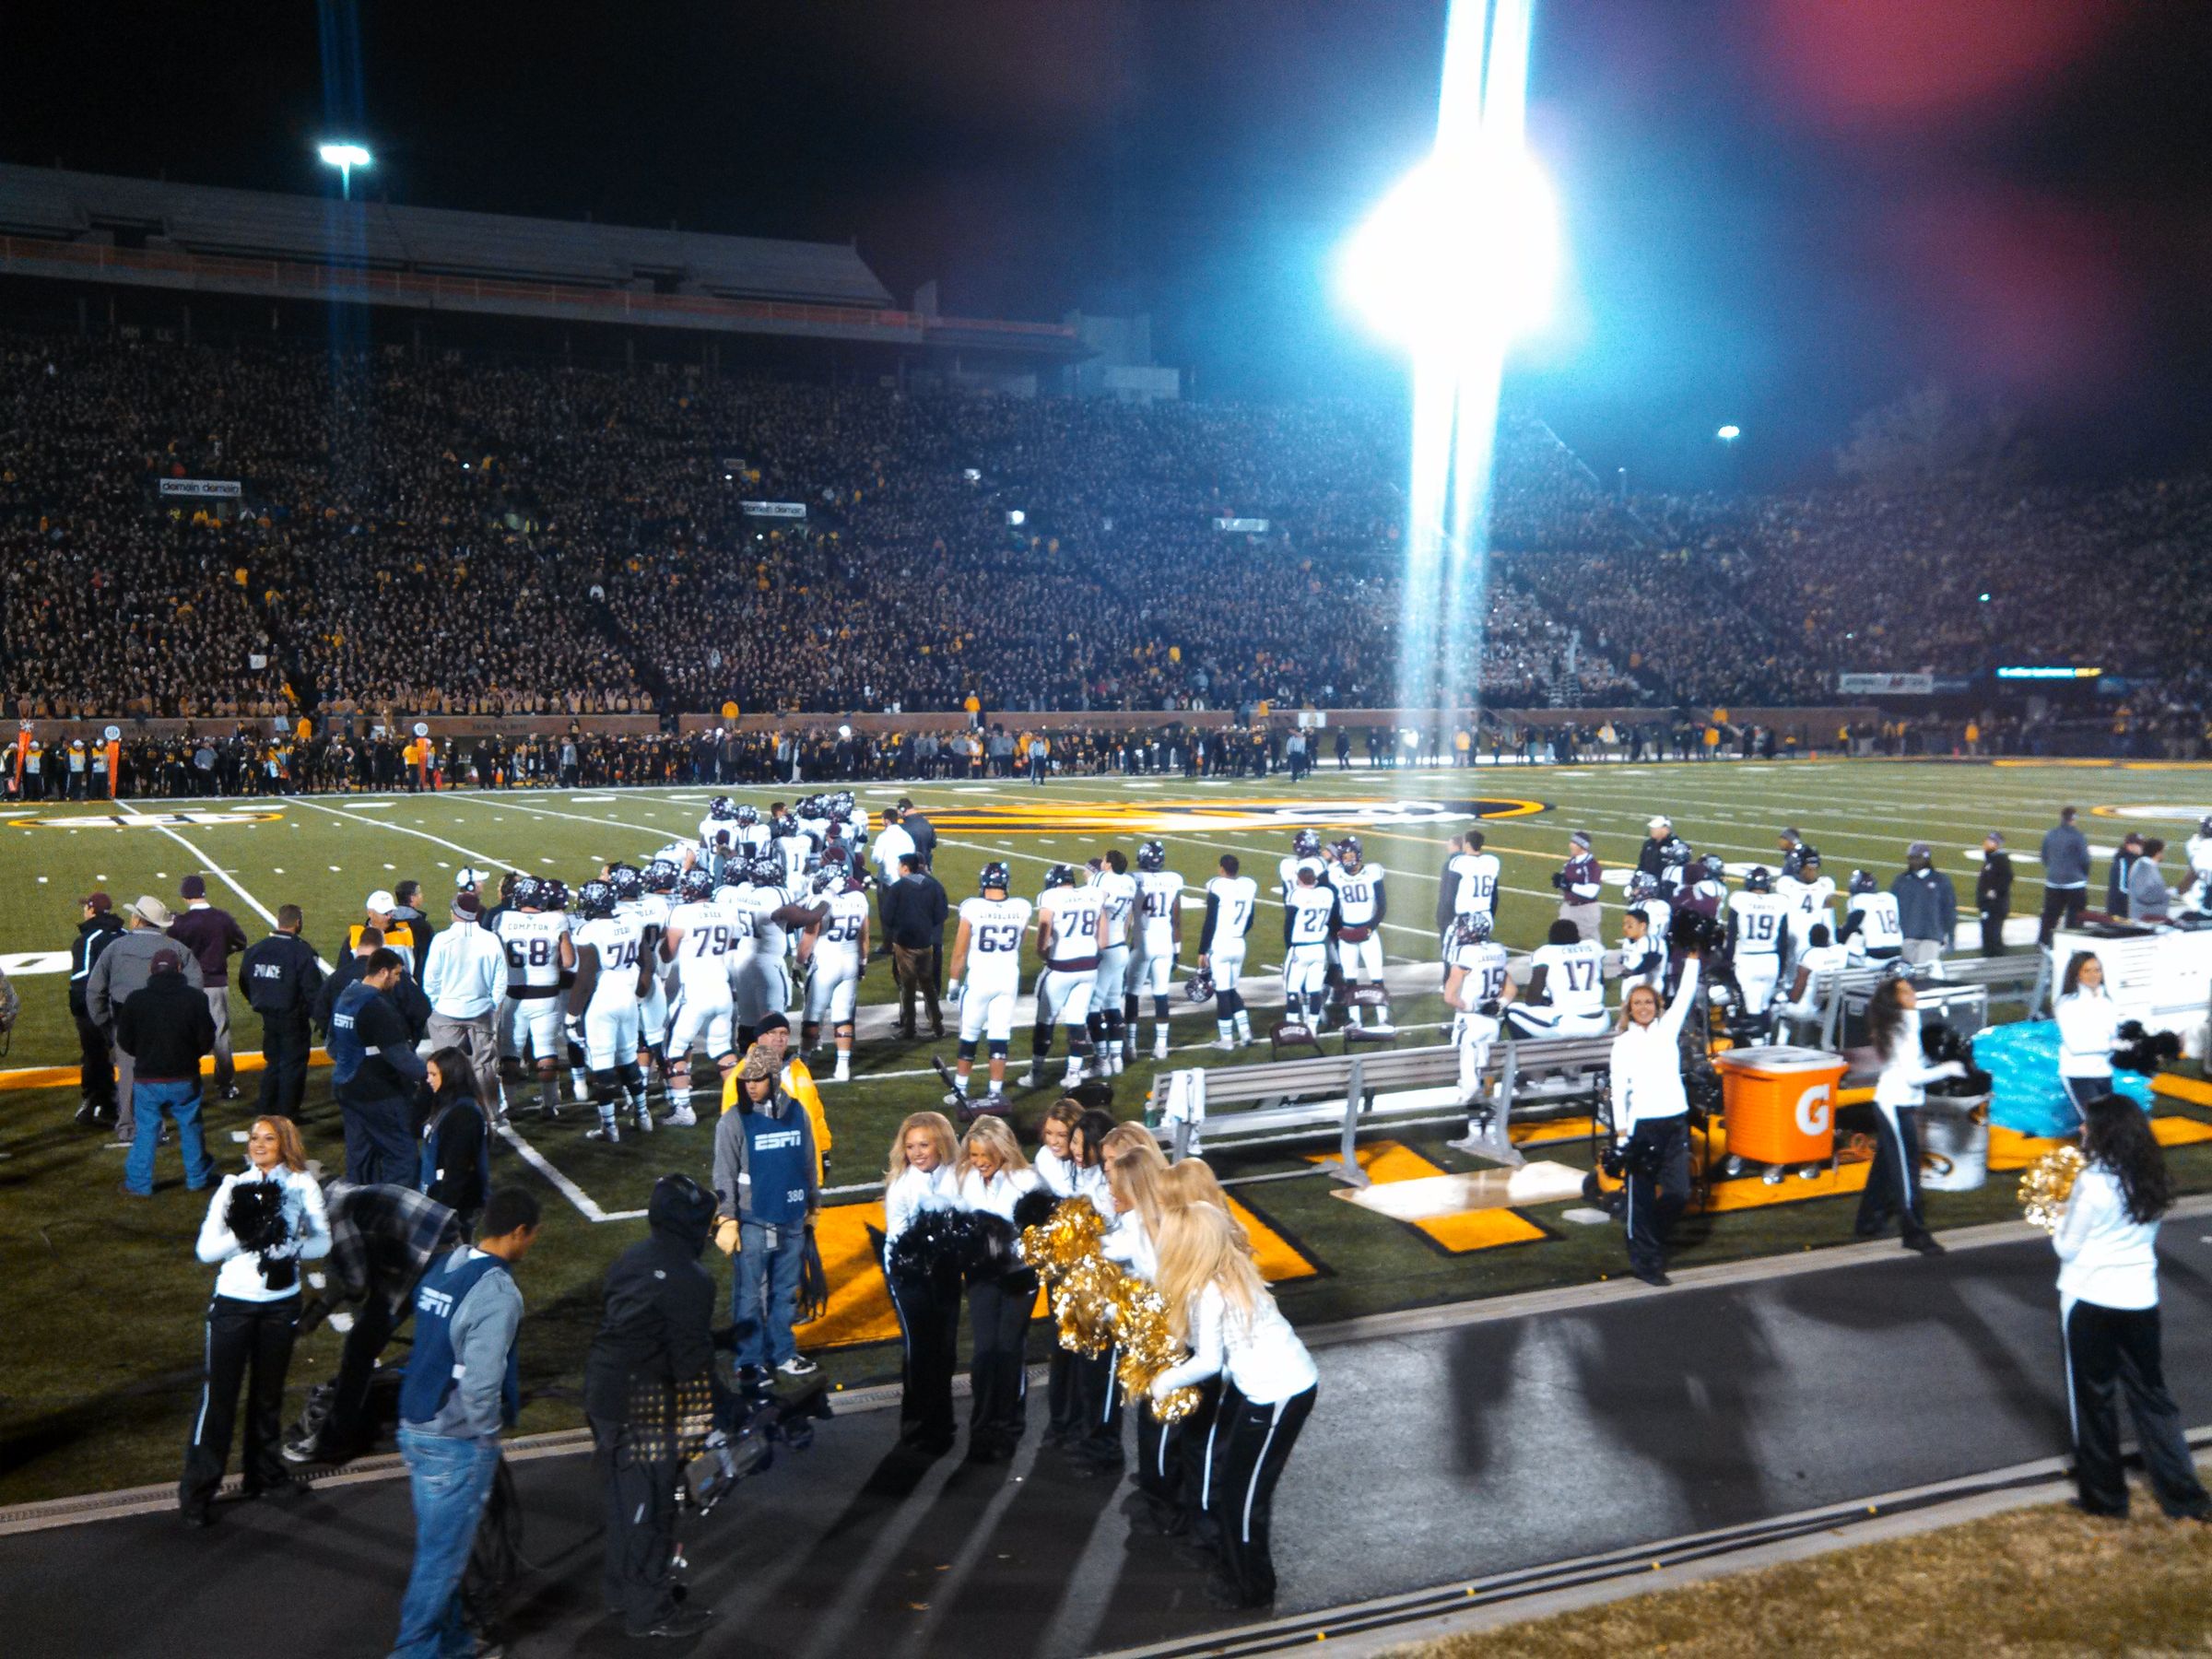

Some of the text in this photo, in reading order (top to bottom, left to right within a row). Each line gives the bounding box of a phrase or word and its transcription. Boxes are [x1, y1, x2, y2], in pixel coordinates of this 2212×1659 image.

[162, 482, 240, 494] domain domain
[1342, 884, 1369, 903] 80
[1473, 875, 1492, 898] 16
[1142, 891, 1167, 918] 41
[1234, 900, 1247, 925] 7
[1801, 894, 1813, 913] 4
[508, 923, 549, 931] COMPTON
[828, 913, 861, 942] 56
[1062, 909, 1096, 938] 78
[1304, 908, 1329, 933] 27
[1746, 913, 1775, 940] 19
[692, 924, 729, 958] 79
[979, 924, 1018, 952] 63
[506, 936, 552, 968] 68
[606, 938, 638, 971] 74
[1479, 967, 1508, 1000] 15
[1563, 959, 1594, 992] 17
[334, 1012, 355, 1030] ESPN
[1794, 1082, 1830, 1136] G
[754, 1130, 801, 1151] ESPN
[786, 1189, 805, 1203] 380
[418, 1286, 453, 1318] SPN
